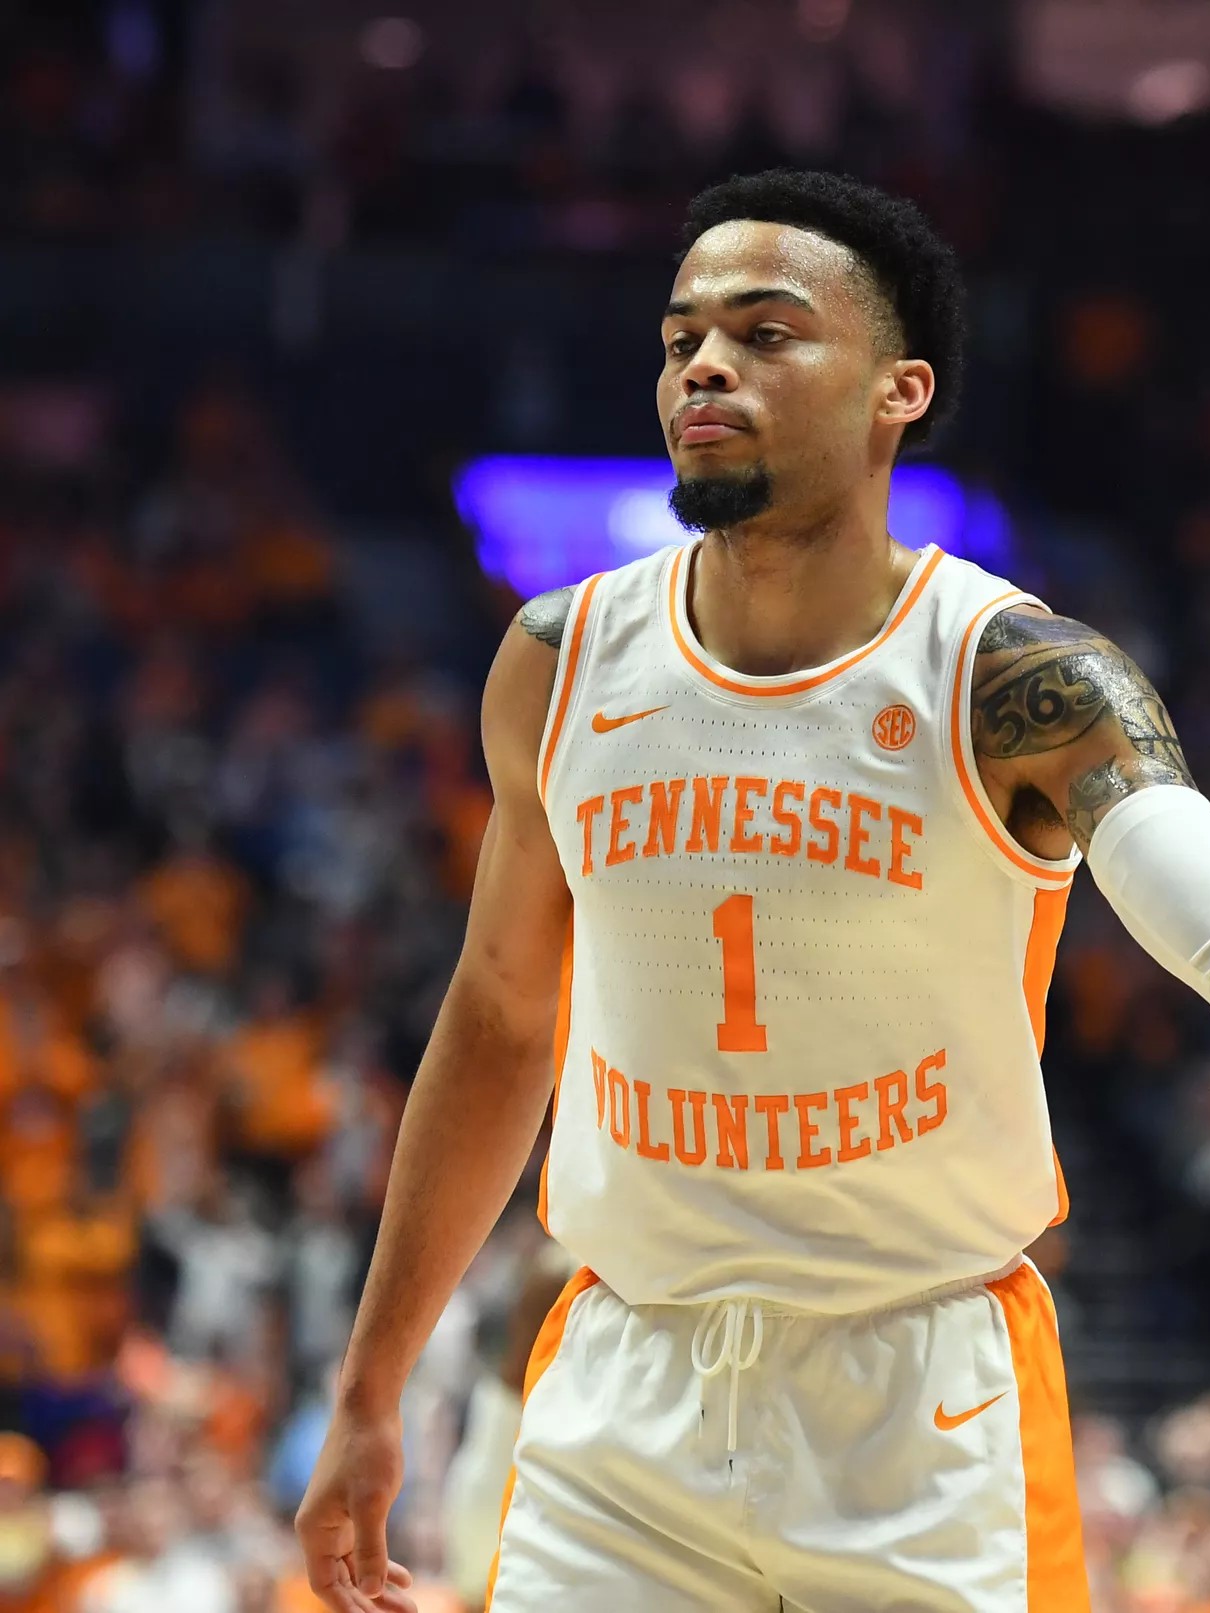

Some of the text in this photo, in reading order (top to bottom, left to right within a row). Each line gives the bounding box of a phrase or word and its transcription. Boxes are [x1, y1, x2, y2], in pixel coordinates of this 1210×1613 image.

[875, 709, 912, 746] SEC
[577, 777, 923, 889] TENNESSEE
[713, 895, 767, 1052] 1
[591, 1047, 948, 1170] VOLUNTEERS
